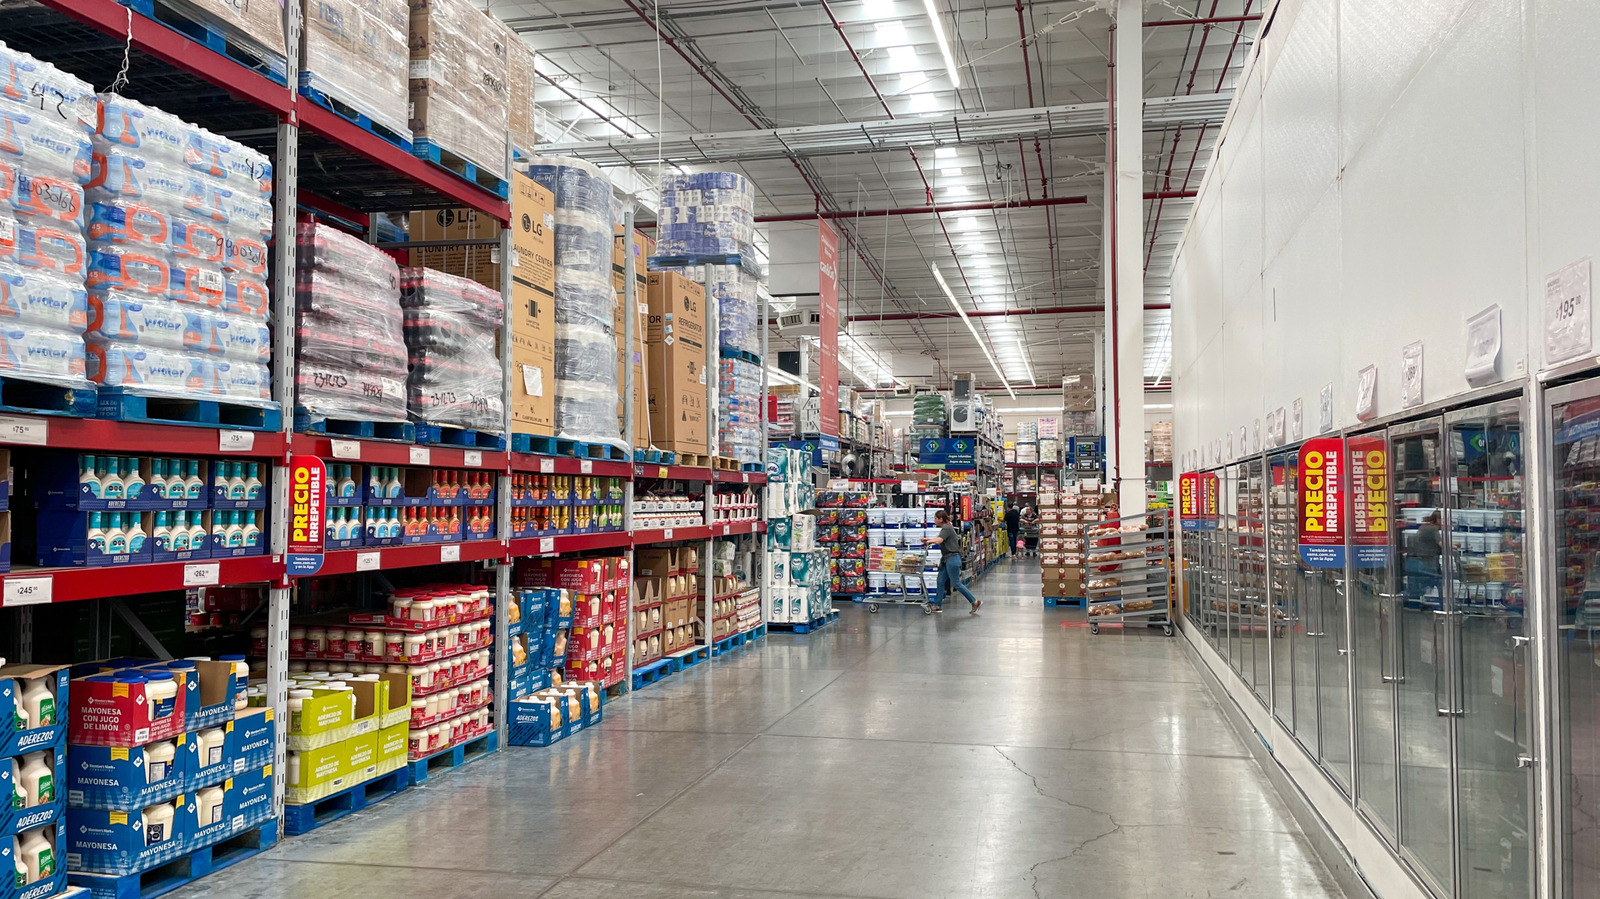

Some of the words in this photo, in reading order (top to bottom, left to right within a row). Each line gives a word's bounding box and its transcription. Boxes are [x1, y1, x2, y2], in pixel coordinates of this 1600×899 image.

[532, 221, 542, 236] LG
[513, 244, 534, 258] AUNDRY
[536, 254, 553, 267] CENTER
[690, 301, 696, 312] LG
[1556, 297, 1574, 321] $195
[1182, 478, 1190, 514] PRECIO
[1305, 451, 1323, 532] PRECIO
[1326, 451, 1337, 532] IRREPETIBLE
[293, 467, 309, 542] PRECIO
[309, 467, 320, 542] IRREPETIBLE
[18, 586, 32, 594] $245
[81, 707, 121, 715] MAYONESA
[100, 715, 119, 723] JUGO
[195, 705, 228, 718] MAYONESA
[95, 723, 118, 731] LIMÓN
[151, 718, 172, 727] MAYONESA
[18, 730, 54, 747] ADEREZOS
[241, 738, 269, 752] MAYONESA
[195, 764, 226, 779] MAYONESA
[78, 777, 119, 786] MAYONESA
[141, 779, 176, 795] MAYONESA
[239, 794, 267, 810] MAYONESA
[16, 810, 53, 828] ADEREZOS
[194, 823, 225, 839] MAYONESA
[75, 841, 118, 850] MAYONESA
[140, 840, 176, 858] MAYONESA
[19, 881, 54, 899] ADEREZOS
